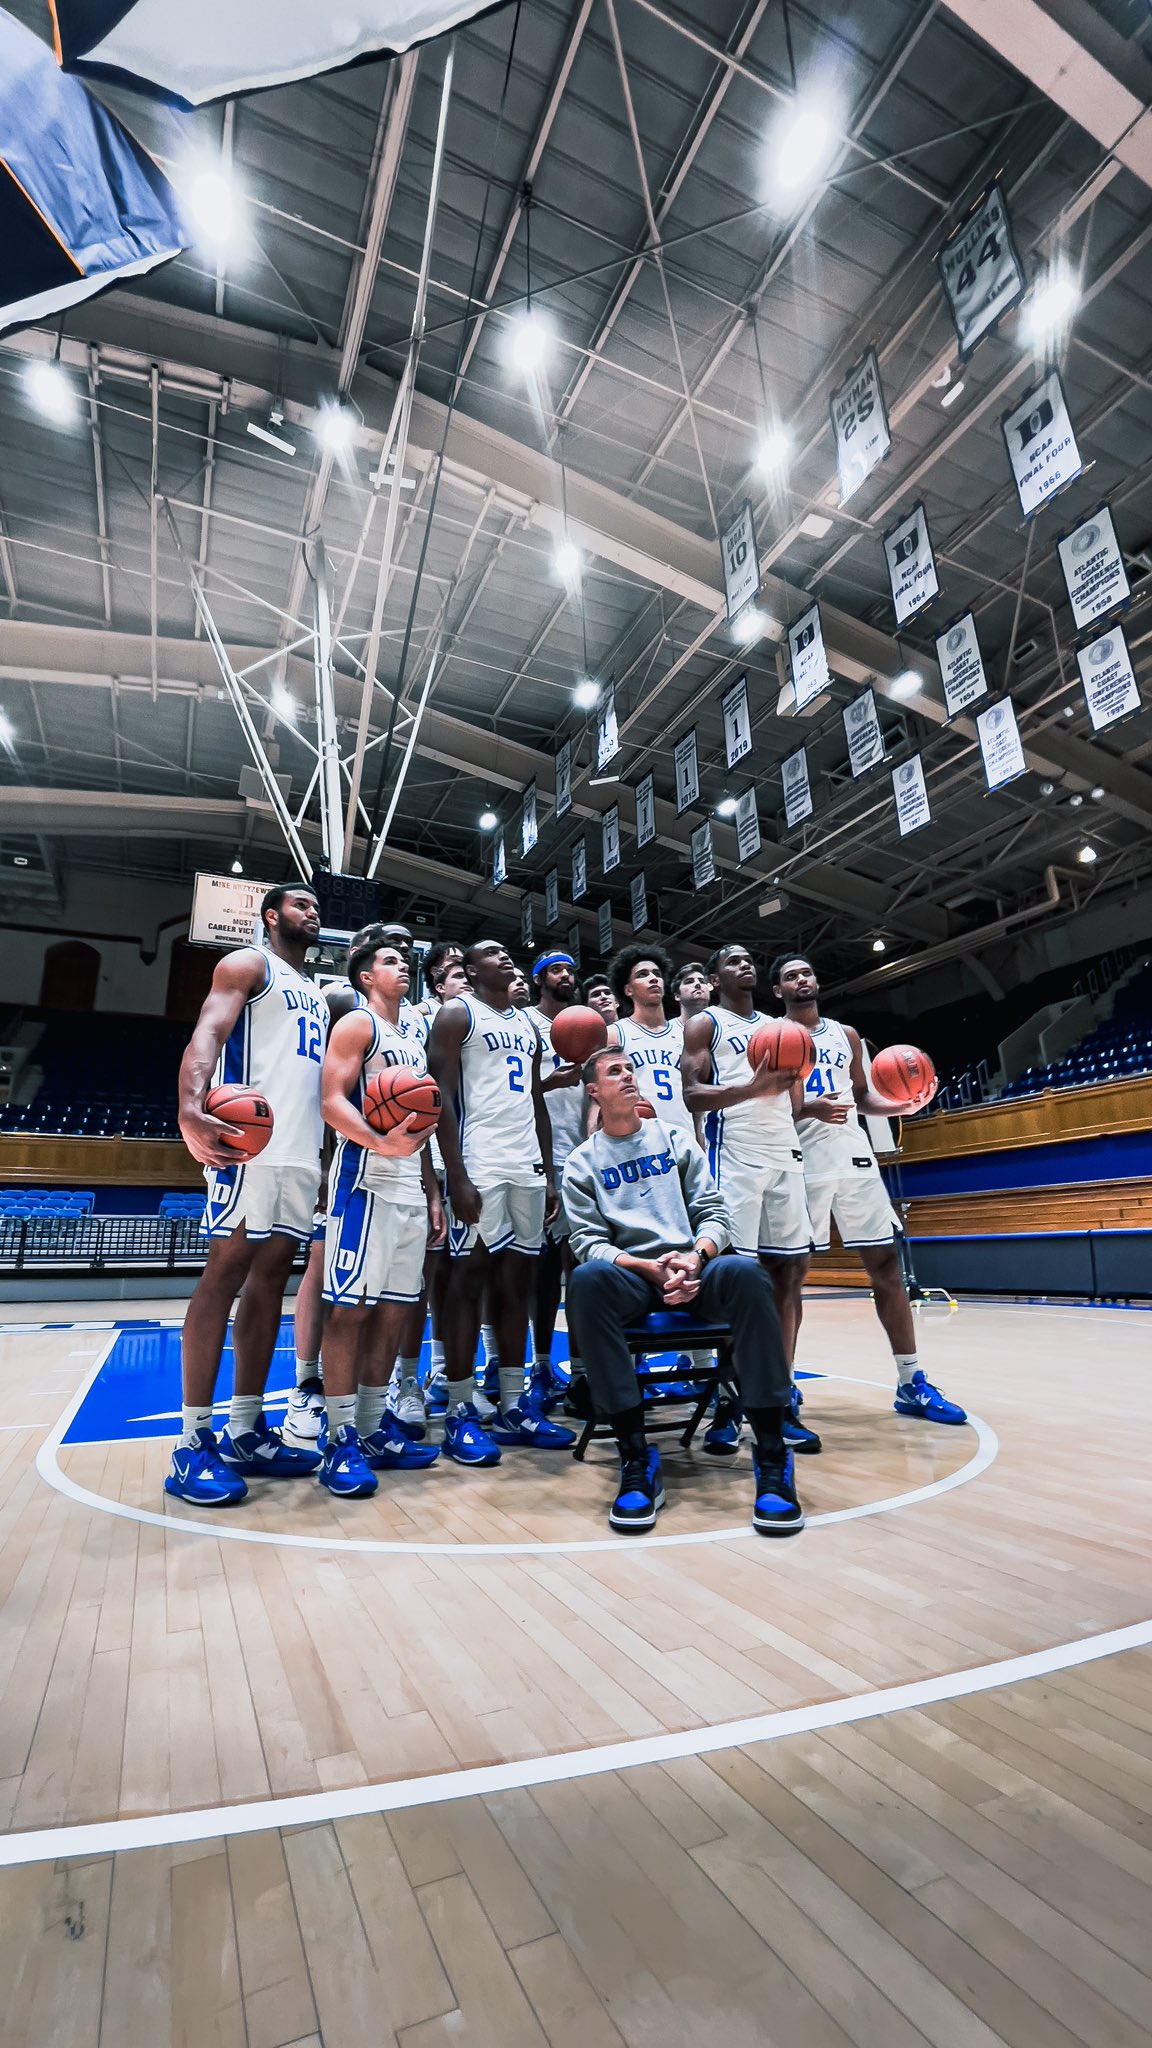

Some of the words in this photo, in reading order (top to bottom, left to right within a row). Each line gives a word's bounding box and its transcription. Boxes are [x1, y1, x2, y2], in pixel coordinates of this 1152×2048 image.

[956, 232, 1002, 295] 44
[842, 391, 875, 443] 25
[1029, 438, 1053, 463] NCAA
[1046, 437, 1071, 462] FOUR
[1038, 470, 1061, 494] 1966
[730, 542, 747, 575] 10
[901, 561, 919, 580] NCAA
[1074, 546, 1109, 577] ATLANTIC
[1081, 559, 1105, 581] COAST
[895, 581, 913, 600] FINAL
[914, 563, 932, 583] FOUR
[1070, 557, 1121, 599] CONFERENCE
[1074, 568, 1120, 605] CHAMPIONS
[908, 590, 925, 608] 1964
[947, 648, 972, 671] ATLANTIC
[952, 658, 970, 675] COAST
[1091, 660, 1121, 683] ATLANTIC
[945, 659, 981, 689] CONFERENCE
[947, 667, 981, 695] CHAMPIONS
[1089, 672, 1132, 702] CONFERENCE
[1097, 671, 1118, 688] COAST
[1092, 681, 1131, 708] CHAMPIONS
[730, 740, 748, 763] 2019
[208, 922, 236, 934] CAREER
[233, 918, 253, 926] MOST
[296, 1016, 322, 1065] 12
[818, 1047, 847, 1070] KE
[506, 1055, 525, 1093] 2
[653, 1069, 674, 1101] 5
[805, 1067, 836, 1098] 41
[600, 1147, 678, 1191] DUKE
